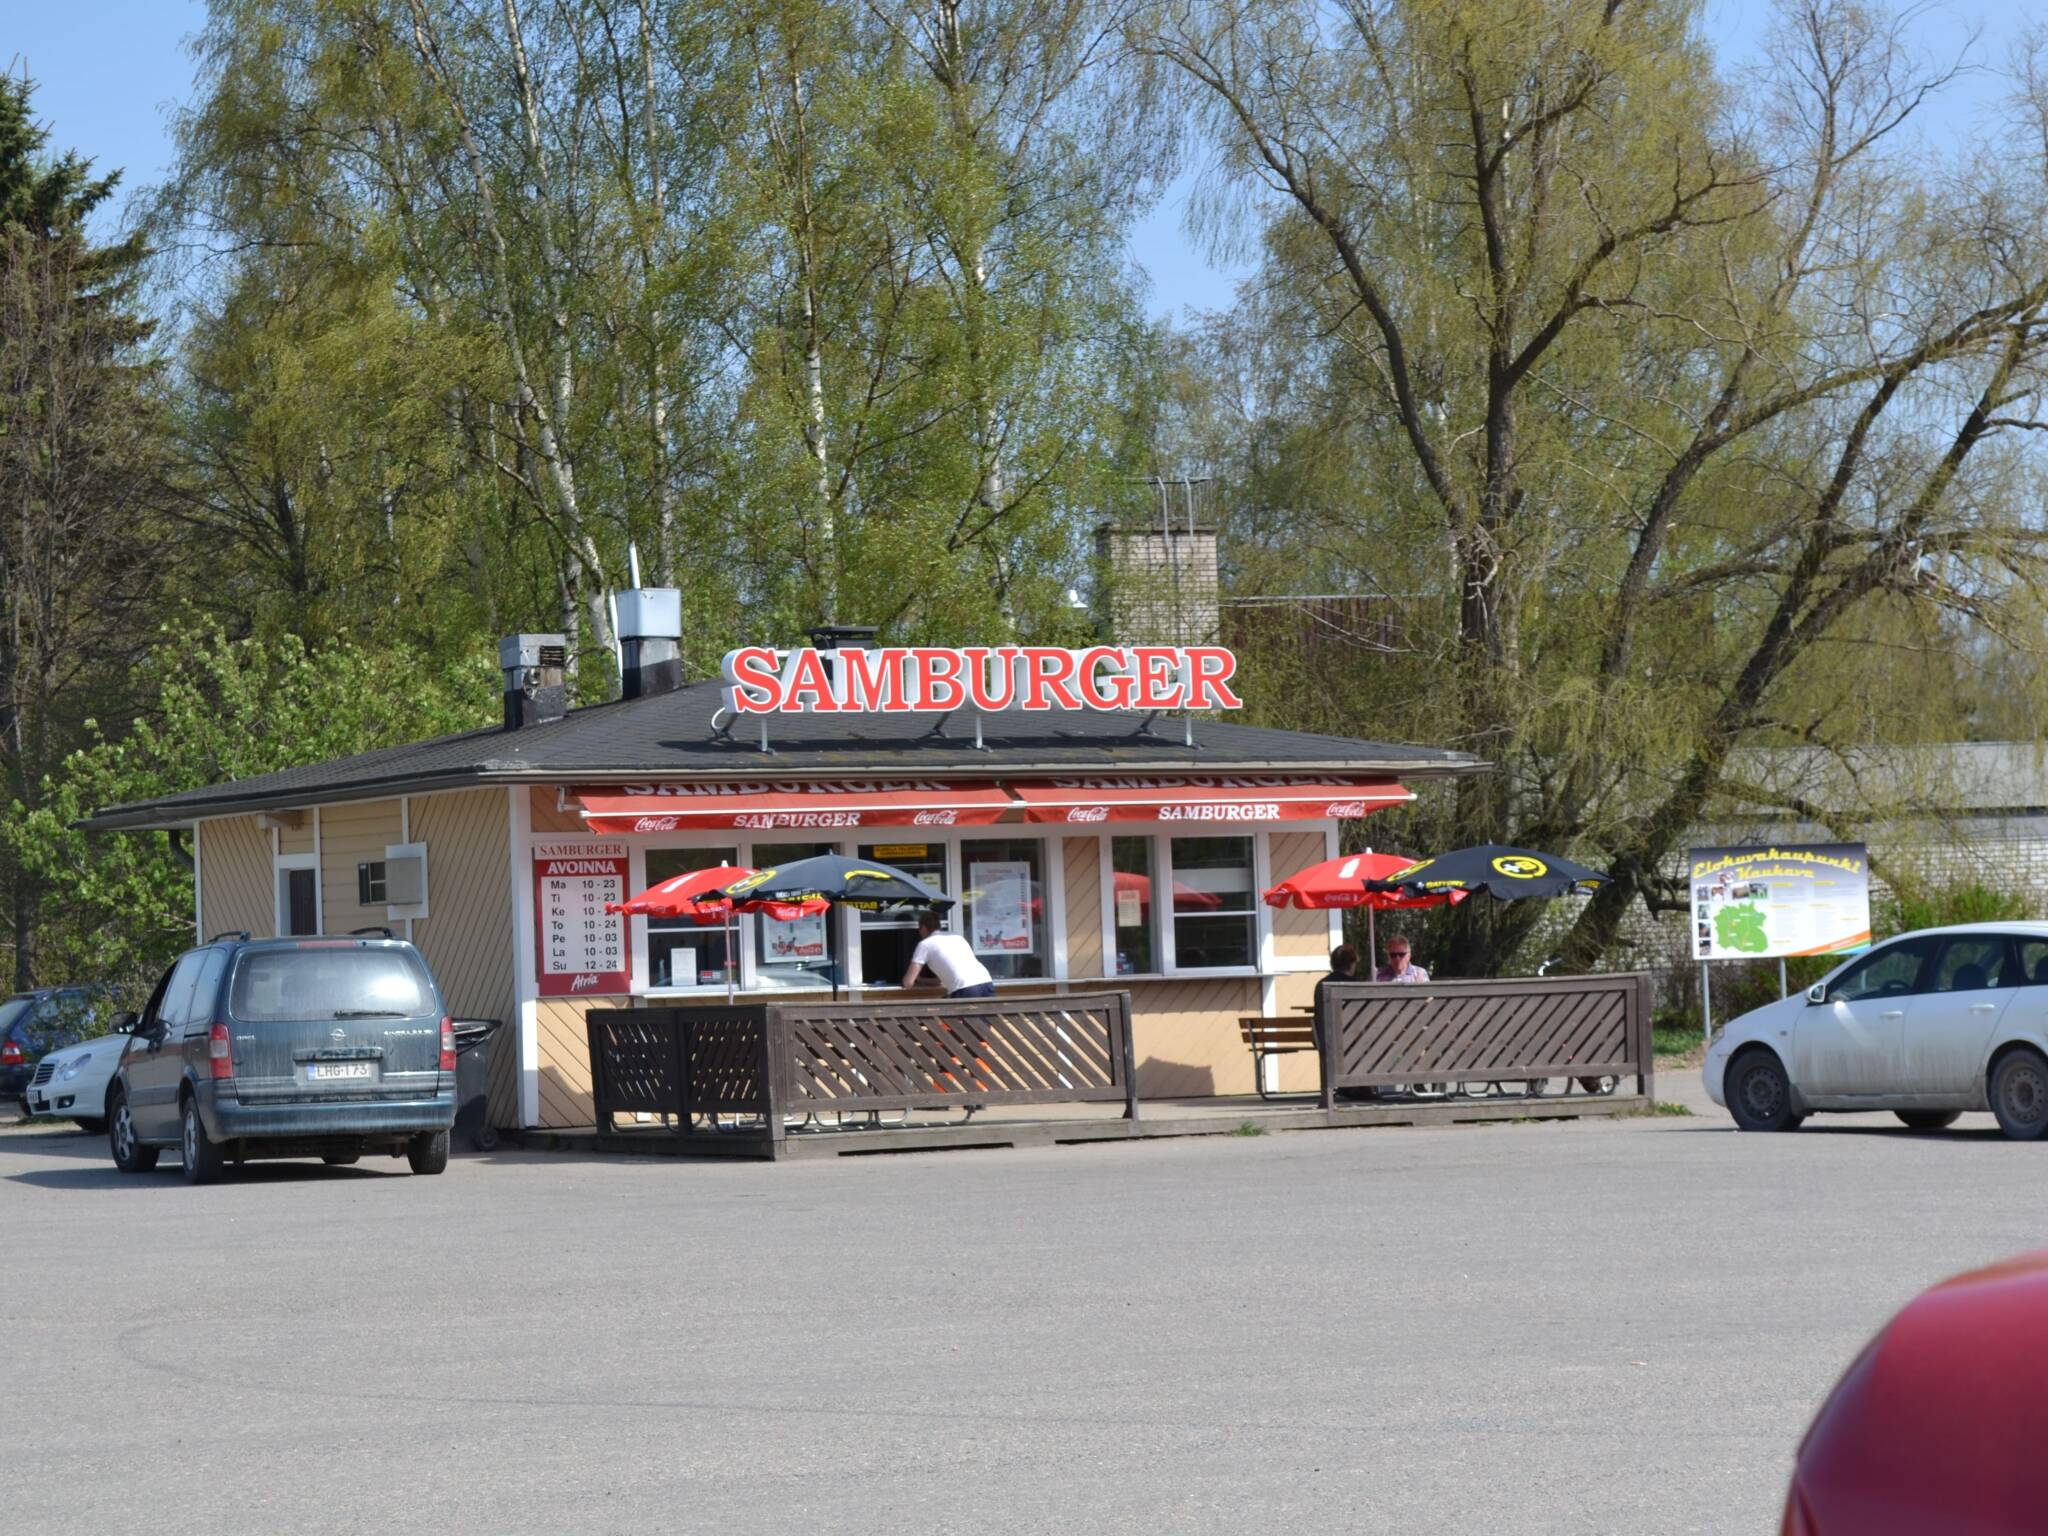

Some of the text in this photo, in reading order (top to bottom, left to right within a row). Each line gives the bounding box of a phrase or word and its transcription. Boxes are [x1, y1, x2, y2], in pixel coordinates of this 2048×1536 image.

[729, 645, 1243, 714] SAMBURGER
[1158, 803, 1280, 820] SAMBURGER
[540, 844, 622, 856] SAMBURGER
[547, 860, 617, 875] AVOINNA
[551, 880, 566, 889] Ma
[582, 880, 594, 888] 10
[603, 880, 616, 888] 23
[551, 893, 560, 902] Ti
[583, 893, 594, 902] 10
[604, 893, 616, 901] 23
[552, 908, 565, 916] Ke
[584, 908, 595, 916] 10
[552, 921, 564, 930] To
[584, 920, 595, 929] 10
[605, 920, 616, 928] 24
[552, 935, 566, 943] Pe
[584, 934, 596, 942] 10
[605, 933, 617, 942] 03
[553, 948, 566, 957] La
[584, 947, 596, 955] 10
[605, 947, 618, 955] 03
[553, 962, 567, 970] Su
[585, 961, 596, 969] 12
[606, 960, 617, 969] 24
[570, 973, 599, 991] Atria
[317, 1064, 368, 1077] LHG-173
